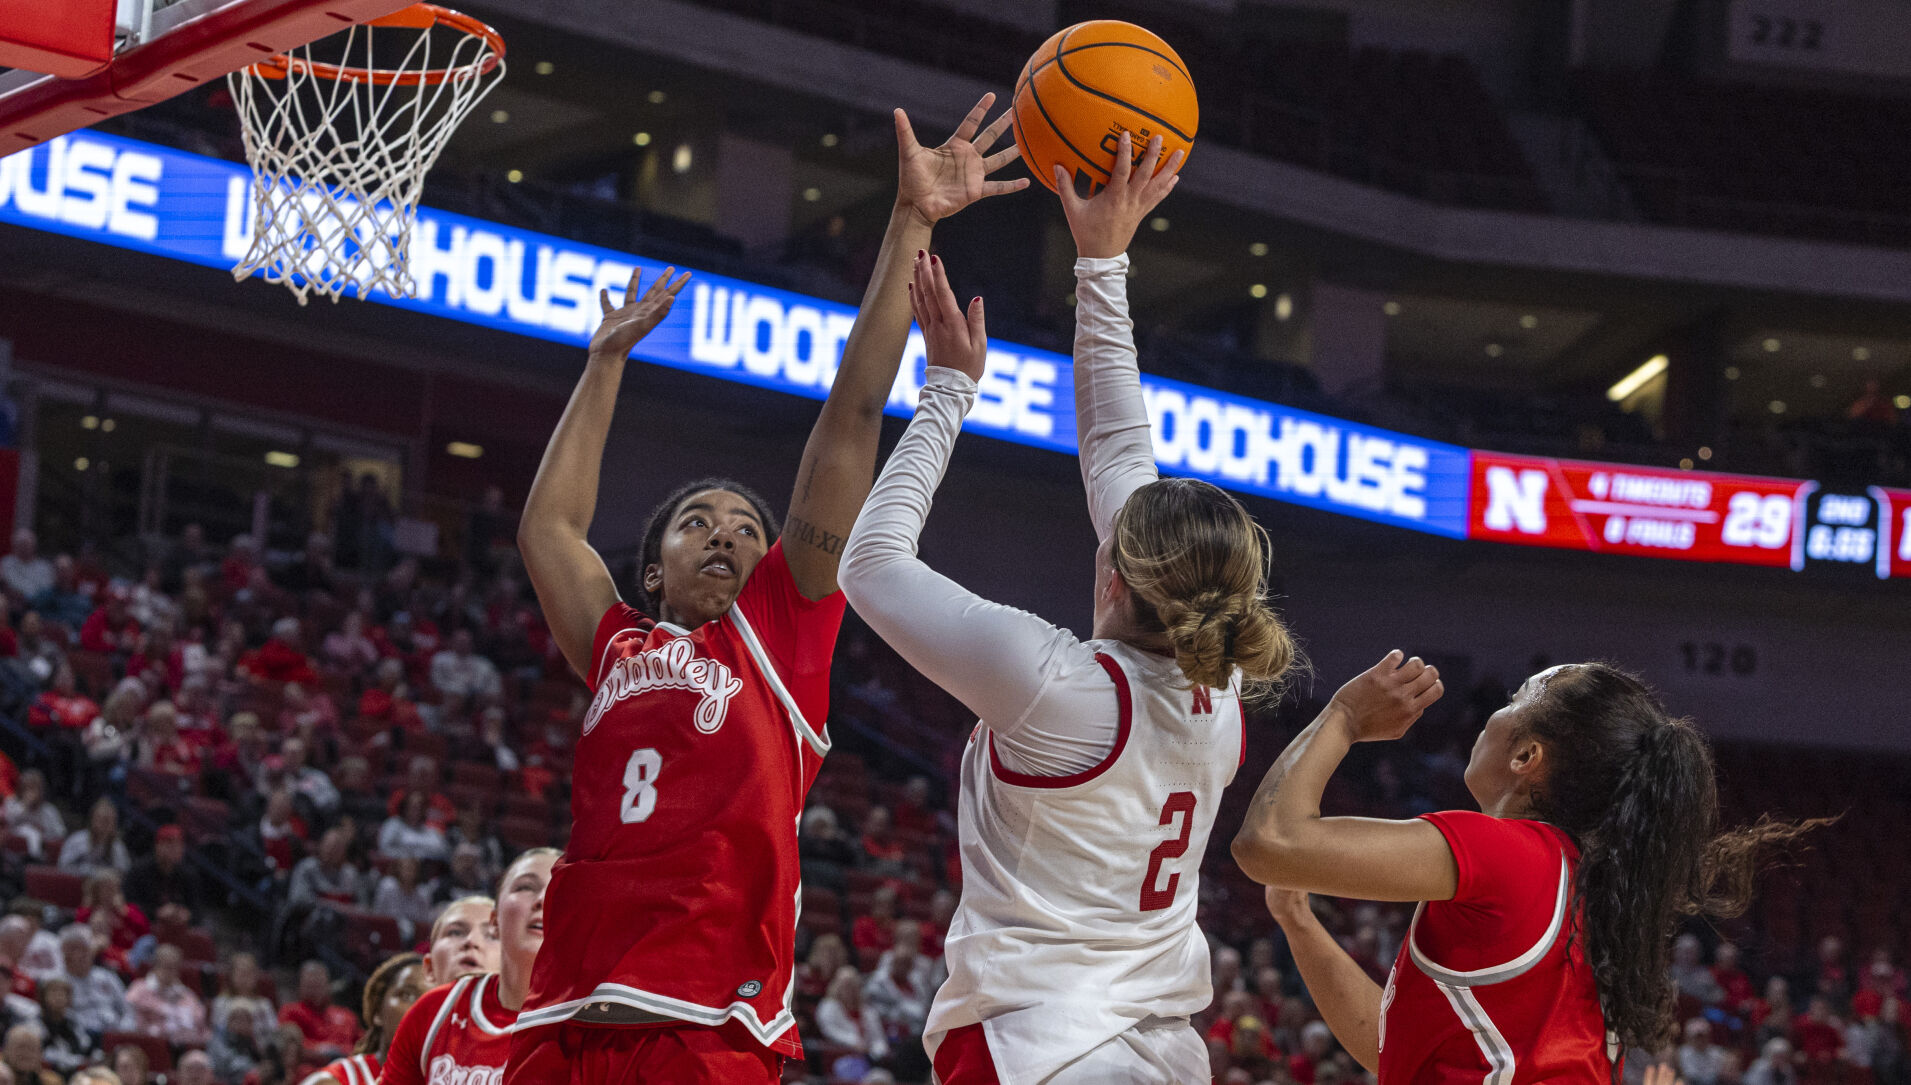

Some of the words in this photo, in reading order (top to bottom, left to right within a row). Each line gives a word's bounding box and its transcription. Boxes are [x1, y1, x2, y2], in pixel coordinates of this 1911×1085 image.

[0, 135, 163, 240] USE
[1141, 384, 1428, 519] OODHOUSE
[1484, 466, 1548, 534] N
[1722, 491, 1793, 549] 29
[583, 637, 744, 736] Bradley
[1191, 684, 1213, 715] N
[620, 747, 663, 824] 8
[1140, 791, 1197, 911] 2
